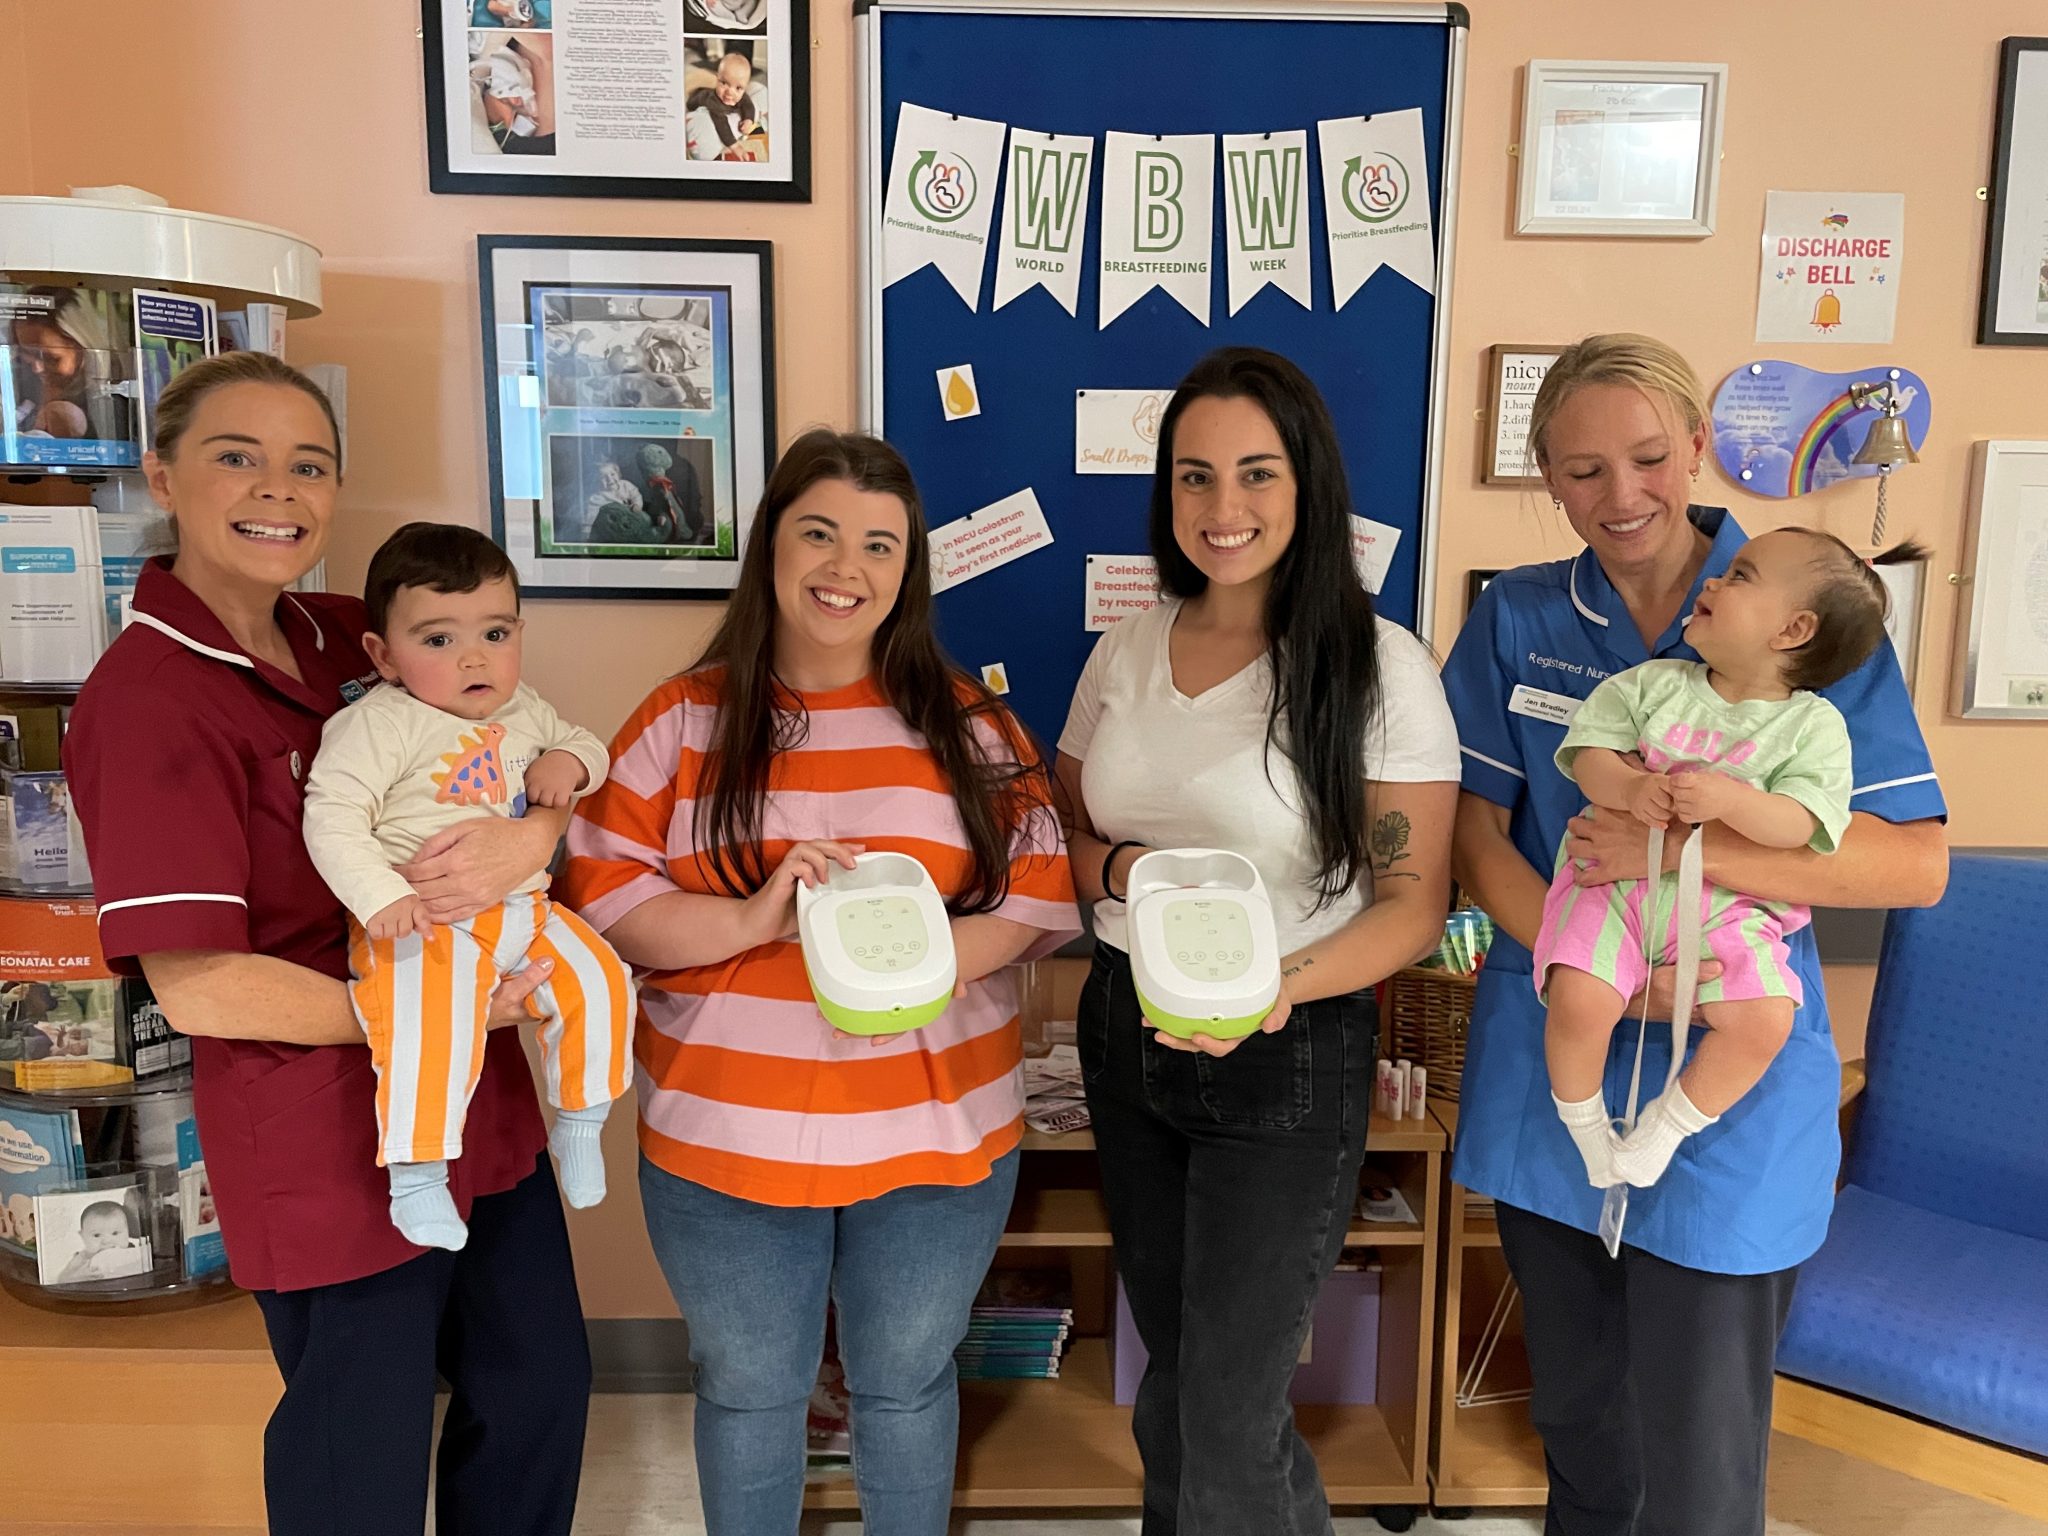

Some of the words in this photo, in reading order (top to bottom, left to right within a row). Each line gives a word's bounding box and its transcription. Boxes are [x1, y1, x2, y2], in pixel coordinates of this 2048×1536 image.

[1014, 145, 1088, 253] W
[1134, 151, 1184, 252] B
[1228, 147, 1302, 252] W
[887, 217, 925, 232] Prioritise
[926, 225, 985, 244] Breastfeeding
[1331, 229, 1369, 241] Prioritise
[1369, 221, 1429, 238] Breastfeeding
[1777, 237, 1891, 258] DISCHARGE
[1015, 257, 1064, 273] WORLD
[1104, 260, 1207, 274] BREASTFEEDING
[1249, 259, 1286, 272] WEEK
[1807, 264, 1855, 285] BELL
[1505, 360, 1549, 379] nicu
[1505, 381, 1536, 391] noun
[1080, 447, 1115, 464] Small
[1116, 448, 1149, 468] Drops
[953, 530, 977, 546] NICU
[977, 510, 1024, 535] colostrum
[956, 551, 965, 559] is
[965, 541, 988, 556] seen
[988, 536, 1000, 545] as
[1000, 525, 1023, 541] your
[946, 560, 979, 578] baby's
[979, 550, 998, 564] first
[999, 531, 1042, 555] medicine
[1098, 597, 1113, 610] by
[1528, 652, 1583, 674] Registered
[1524, 697, 1538, 707] Jen
[1539, 701, 1569, 715] Bradley
[34, 847, 68, 856] Hello
[58, 956, 91, 967] CARE
[134, 1030, 152, 1041] THE
